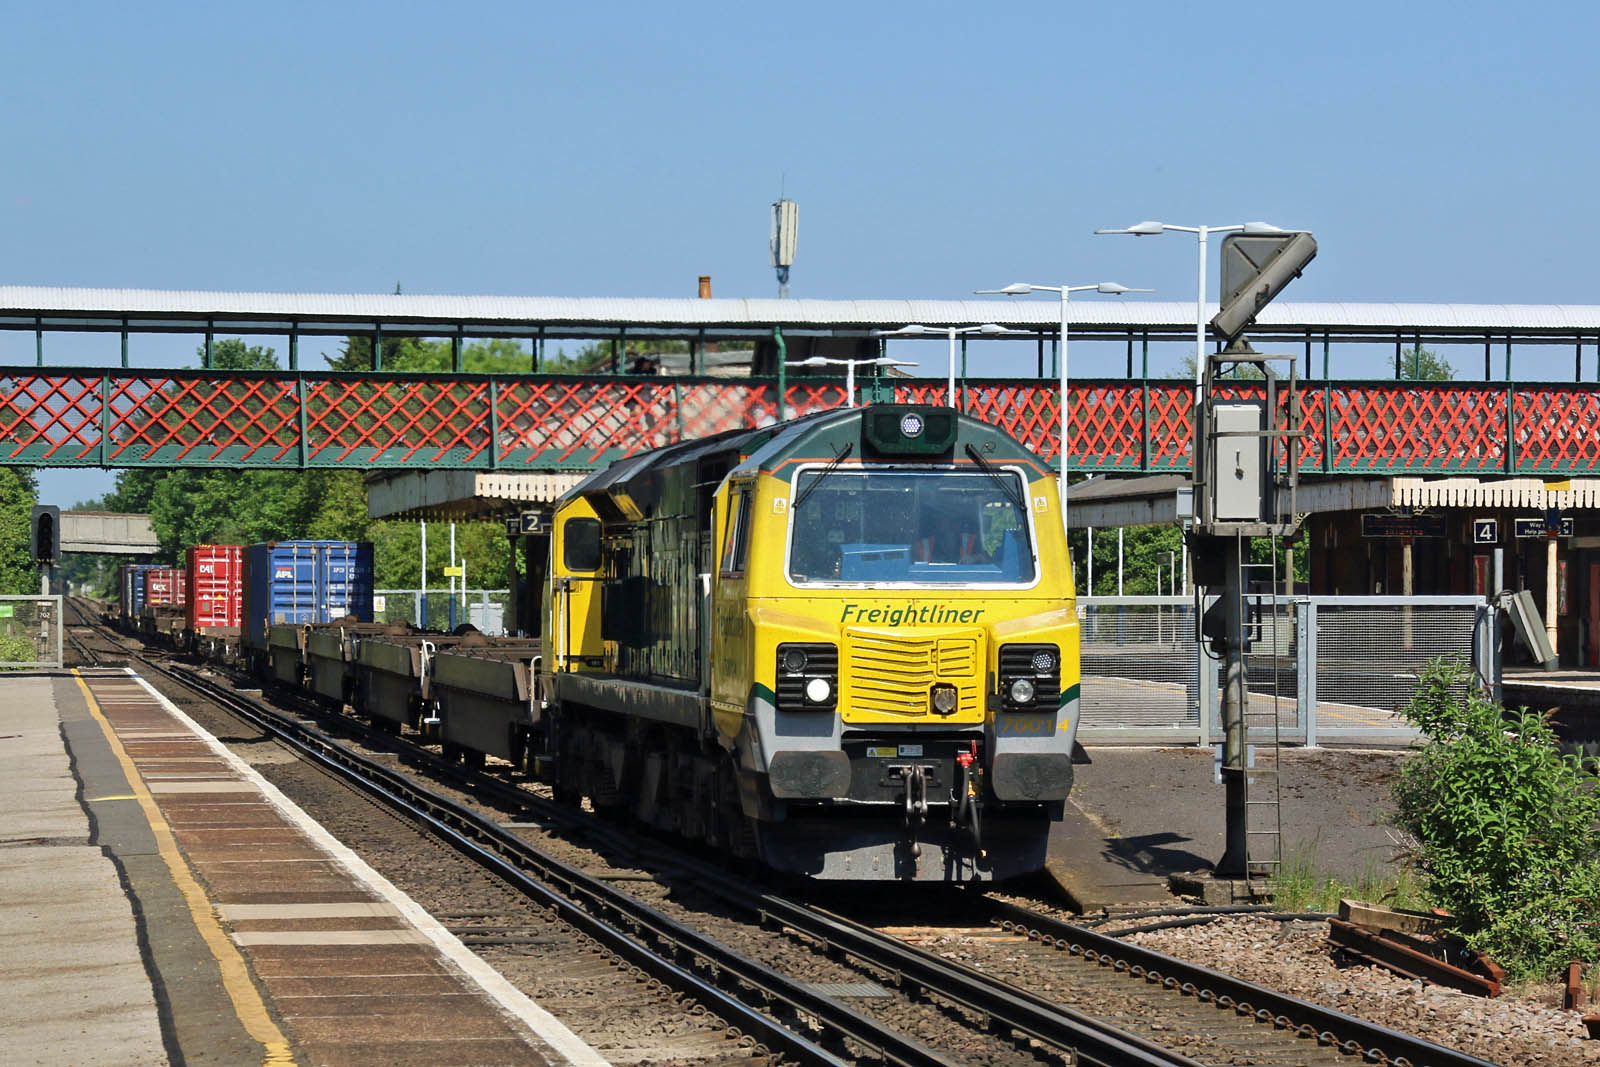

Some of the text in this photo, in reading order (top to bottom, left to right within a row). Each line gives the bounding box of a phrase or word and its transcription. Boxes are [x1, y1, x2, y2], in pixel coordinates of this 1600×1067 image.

[526, 515, 538, 530] 2
[1479, 524, 1492, 540] 4
[275, 570, 294, 579] APL
[840, 604, 985, 627] Freightliner
[1001, 717, 1070, 734] 70014
